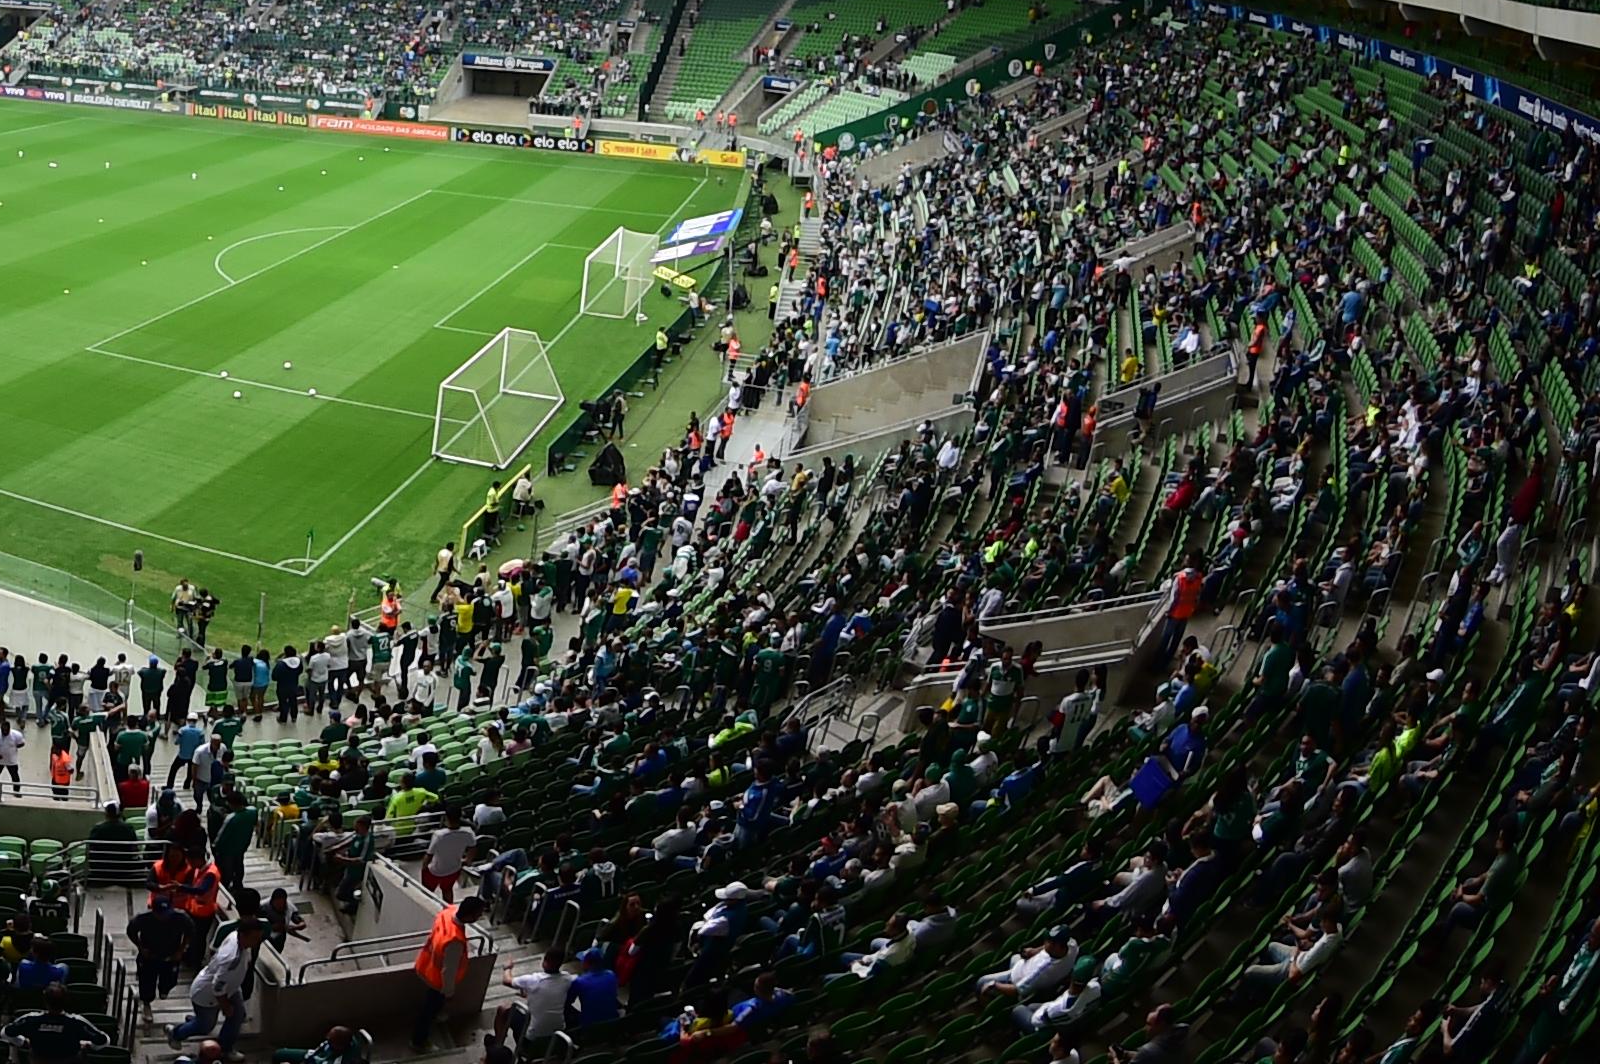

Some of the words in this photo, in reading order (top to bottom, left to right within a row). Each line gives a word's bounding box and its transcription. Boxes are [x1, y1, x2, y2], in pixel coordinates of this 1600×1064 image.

[474, 55, 503, 67] Allianz
[516, 59, 544, 70] Parque
[195, 105, 217, 117] Itaú
[224, 107, 246, 119] Itaú
[254, 110, 276, 123] Itaú
[284, 113, 307, 126] Itaú
[472, 130, 492, 143] elo
[534, 135, 555, 148] elo
[558, 138, 578, 151] elo
